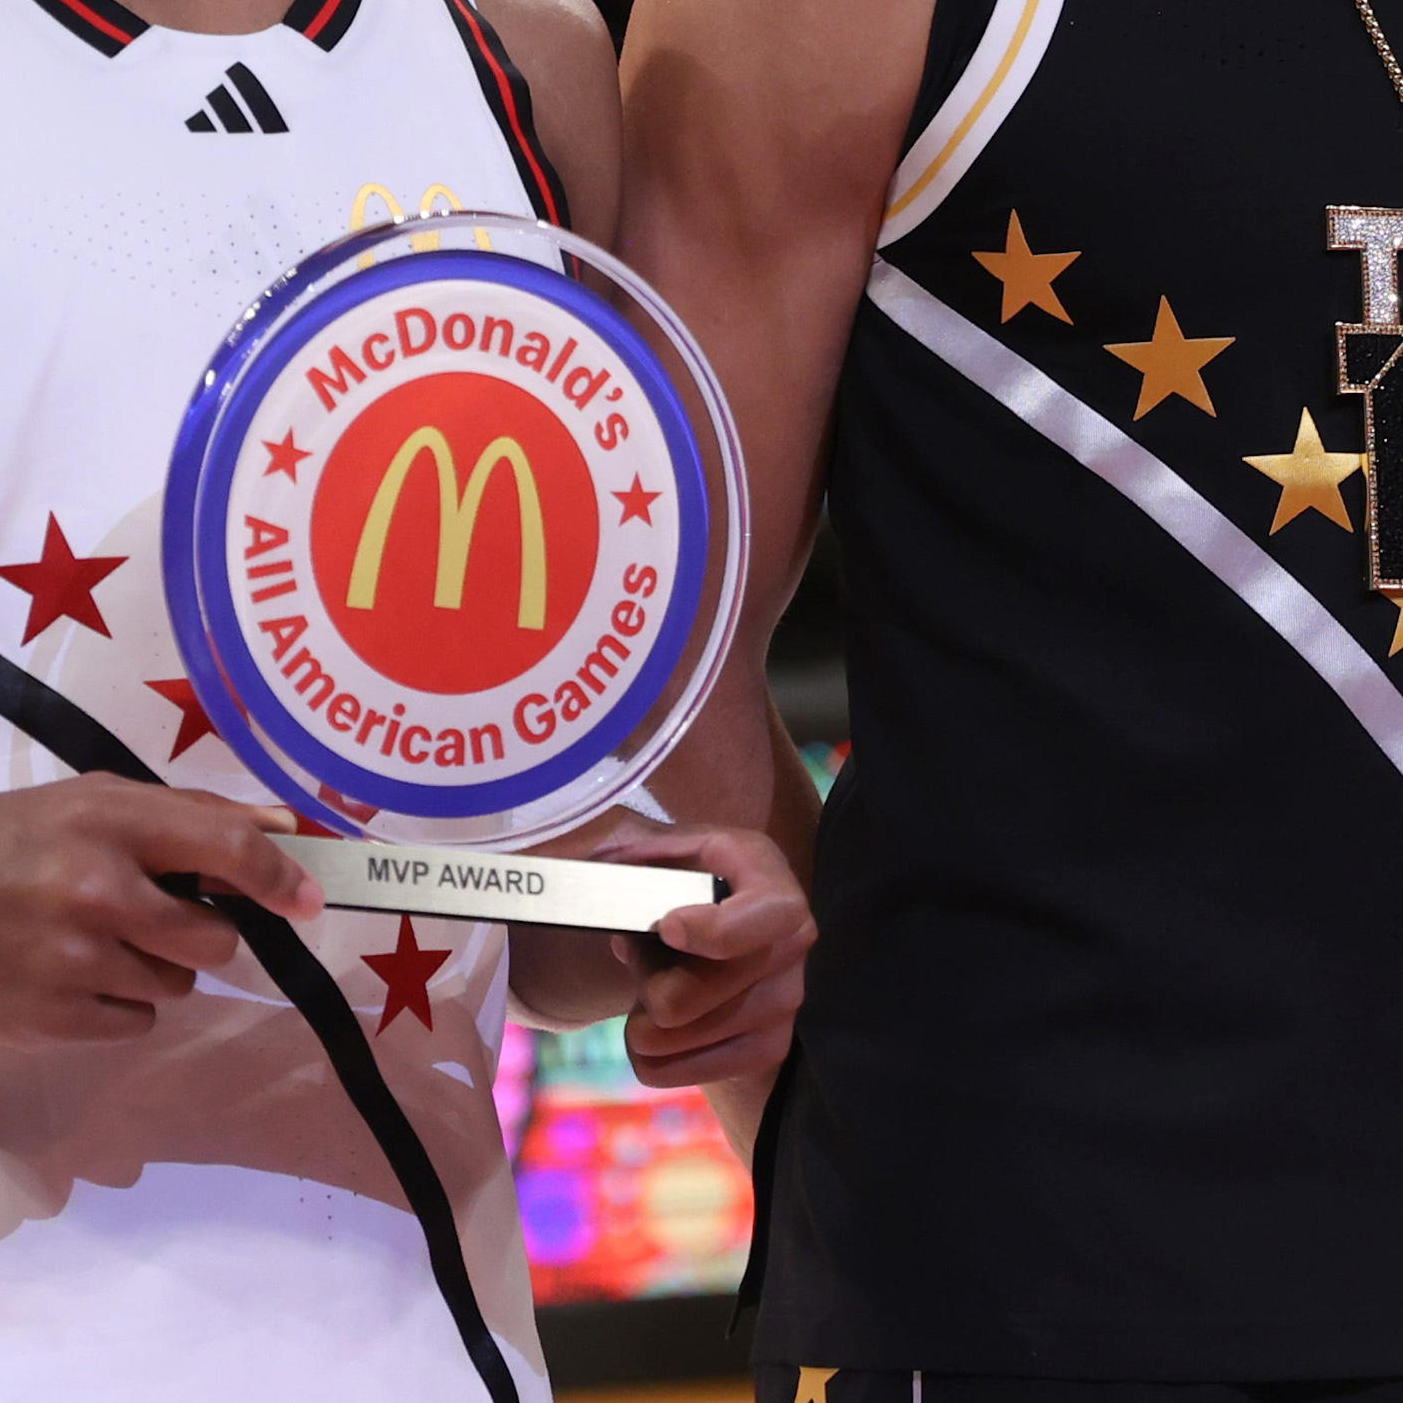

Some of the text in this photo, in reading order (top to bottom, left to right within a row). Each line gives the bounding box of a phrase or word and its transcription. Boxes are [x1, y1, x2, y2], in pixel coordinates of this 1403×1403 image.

[307, 307, 630, 451] McDonald's
[244, 514, 658, 767] All American Games
[367, 857, 545, 895] MVP AWARD
